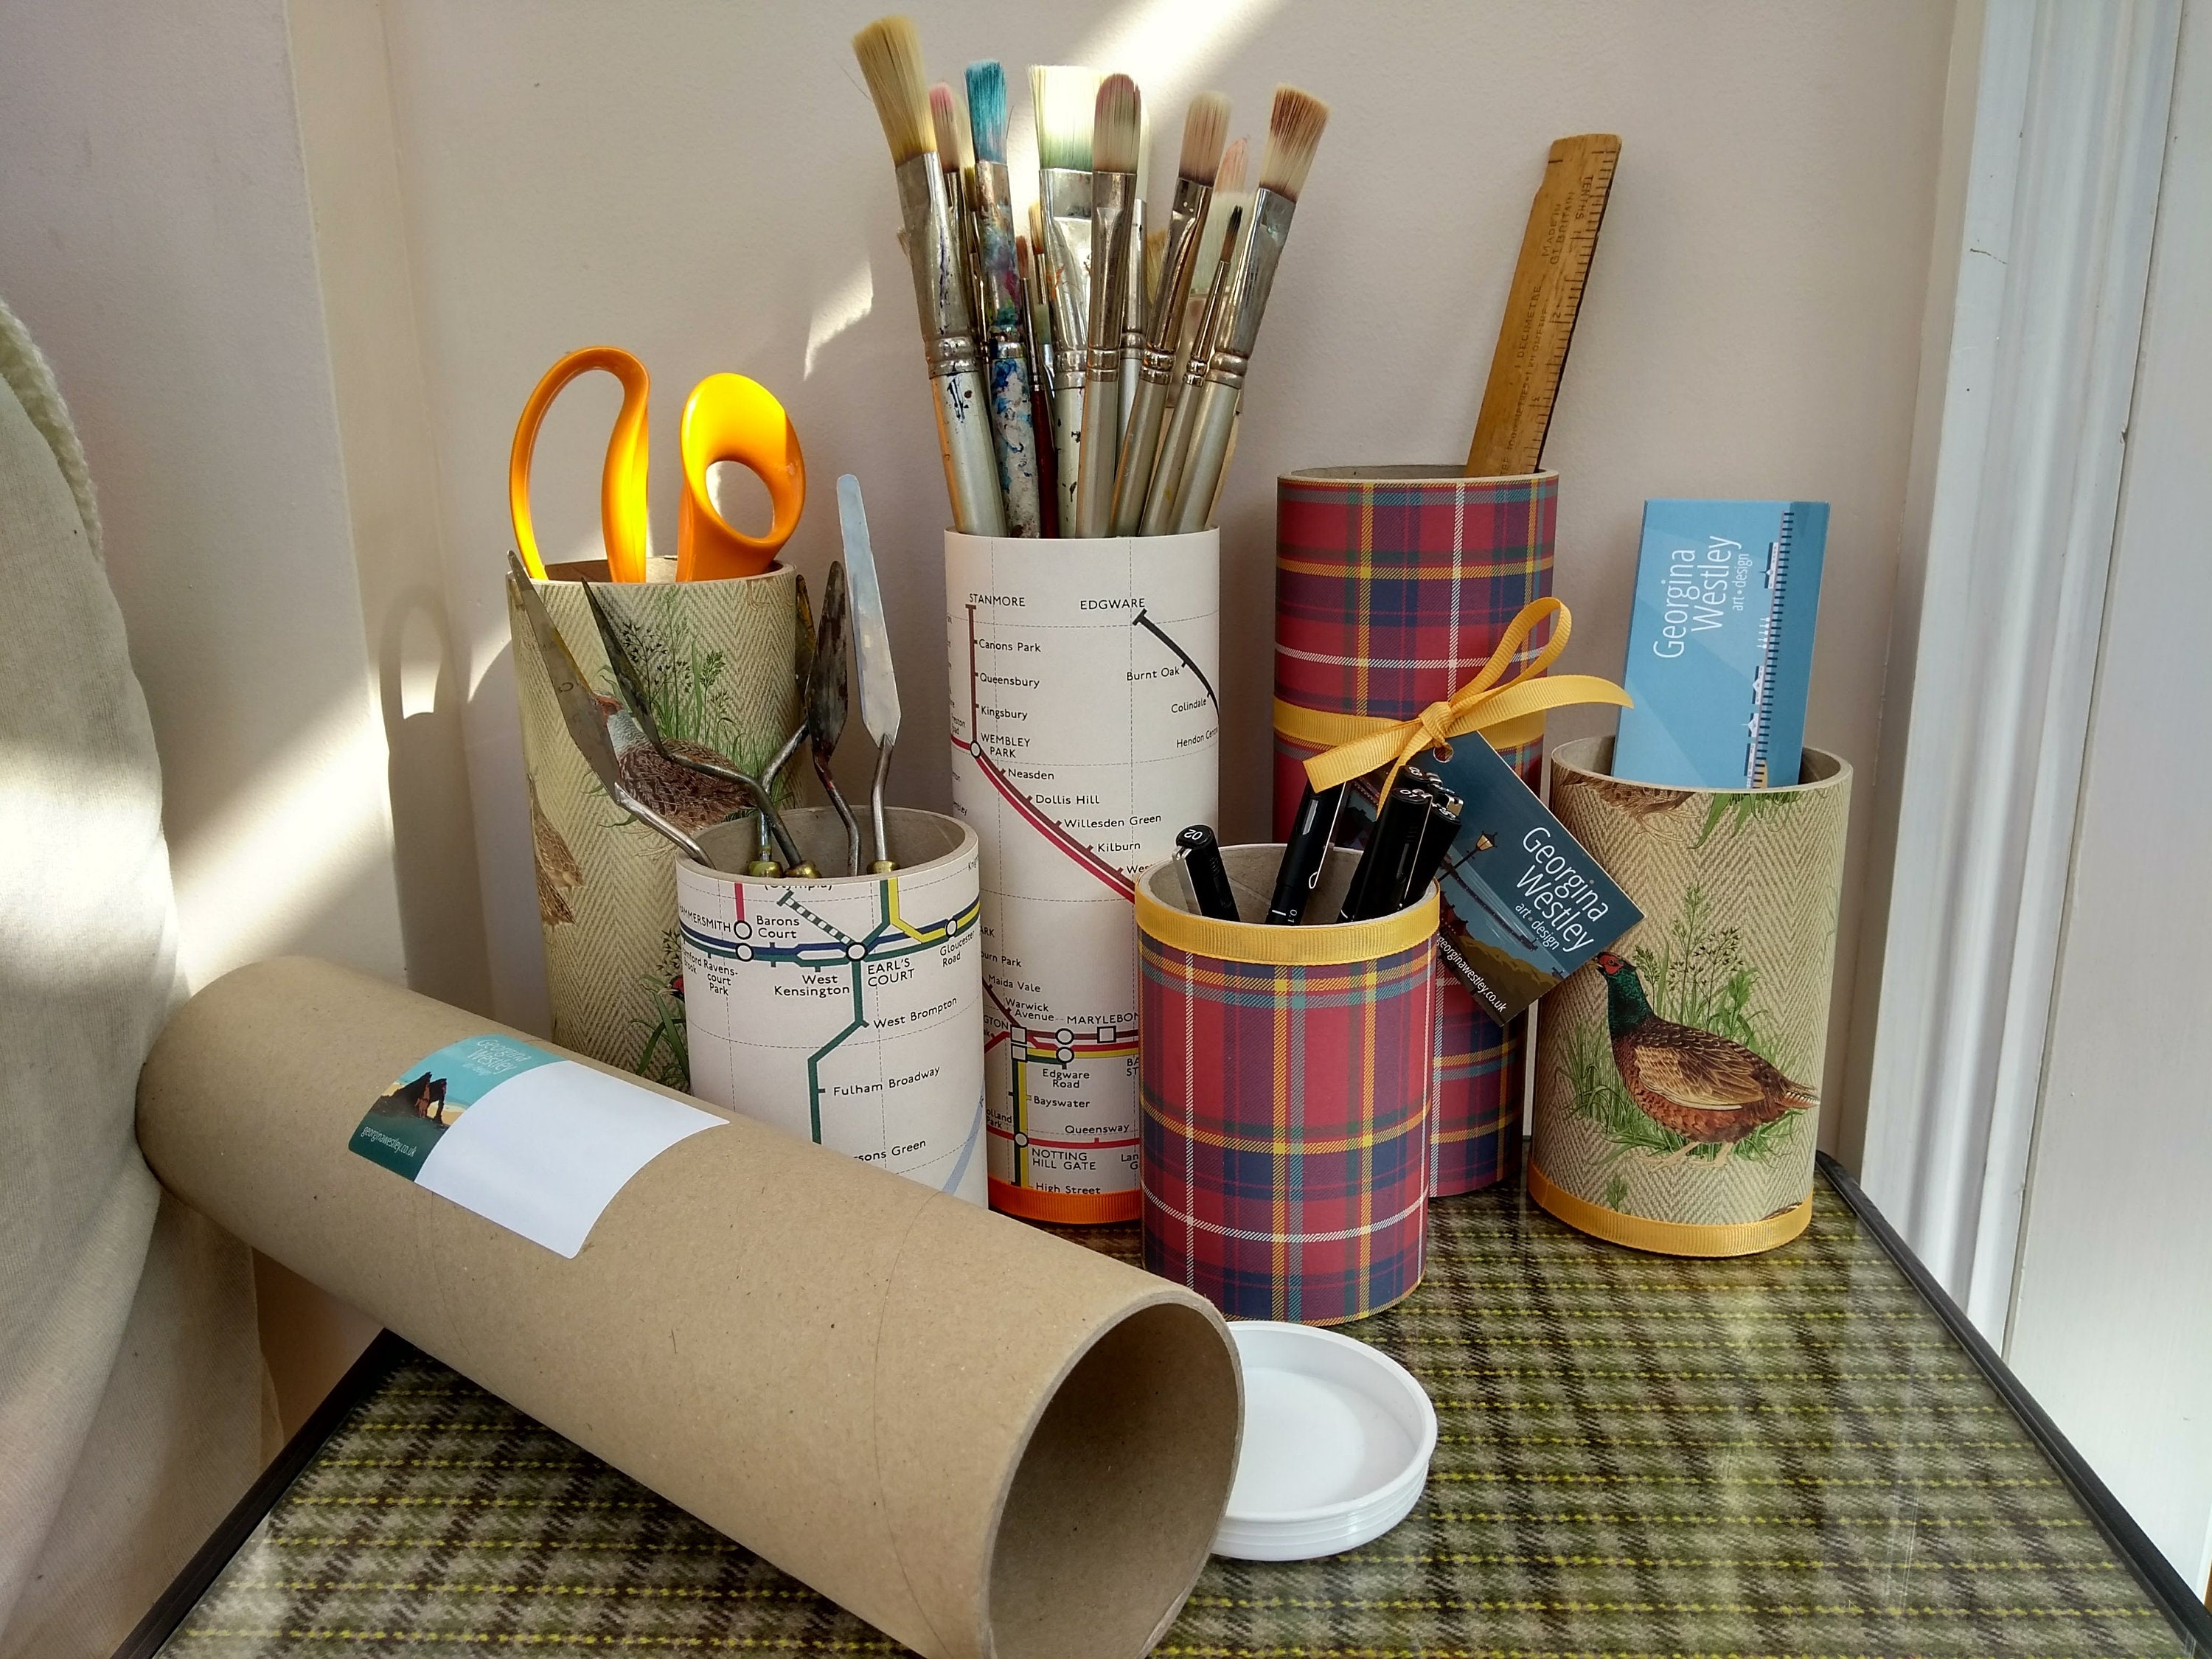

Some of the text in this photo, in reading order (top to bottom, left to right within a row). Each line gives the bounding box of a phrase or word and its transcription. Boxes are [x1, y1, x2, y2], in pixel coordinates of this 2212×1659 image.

[1575, 175, 1593, 220] TENTHS
[1517, 285, 1541, 358] DECIMETRE
[1691, 535, 1742, 632] Westley
[1731, 553, 1753, 611] art design
[969, 593, 1026, 607] STANMORE
[1080, 597, 1146, 611] EDGWARE
[1653, 549, 1700, 658] Georgina
[979, 639, 1042, 653] Canons Park
[980, 672, 1040, 689] Queensbury
[1126, 667, 1180, 681] Burnt Oak
[1171, 698, 1206, 713] Colindale
[981, 706, 1028, 720] Kingsbury
[981, 733, 1031, 748] WEMBLEY
[1176, 735, 1204, 748] Hendon
[990, 747, 1016, 759] PARK
[1008, 768, 1054, 780] Neasden
[1035, 794, 1100, 804] Dollis Hill
[1064, 813, 1162, 829] Willesden Green
[1183, 829, 1203, 841] 02
[1097, 841, 1141, 852] Kilburn
[1127, 864, 1150, 874] We
[1522, 827, 1610, 922] Georgina
[1516, 864, 1595, 953] Westley
[757, 915, 800, 926] Barons
[1514, 902, 1560, 950] art design
[758, 928, 797, 939] Court
[980, 925, 995, 938] ARK
[939, 930, 975, 956] Gloucester
[942, 951, 961, 967] Road
[1001, 956, 1022, 967] Park
[703, 959, 738, 976] Ravens-
[868, 958, 911, 975] EARL'S
[707, 973, 731, 986] court
[802, 975, 838, 984] West
[868, 968, 915, 987] COURT
[1436, 936, 1507, 1013] georginawestley.co.uk
[709, 983, 728, 995] Park
[988, 974, 1041, 992] Maida Vale
[774, 985, 850, 998] Kensington
[1005, 997, 1049, 1012] Warwick
[874, 997, 958, 1029] West Brompton
[1015, 1009, 1054, 1022] Avenue
[1067, 1012, 1138, 1024] MARYLEBON
[478, 1039, 532, 1062] Georgina
[467, 1048, 518, 1074] Westley
[833, 1065, 941, 1096] Fulham Broadway
[1043, 1068, 1090, 1081] Edgware
[1052, 1079, 1080, 1088] Road
[1034, 1096, 1091, 1107] Bayswater
[986, 1108, 1012, 1124] olland
[987, 1114, 1002, 1129] Park
[1065, 1124, 1130, 1135] Queensway
[361, 1125, 417, 1158] georginawestley.co.uk
[853, 1140, 926, 1161] sons Green
[1032, 1148, 1088, 1161] NOTTING
[1033, 1158, 1096, 1170] HILL GATE
[1036, 1182, 1101, 1194] High Street
